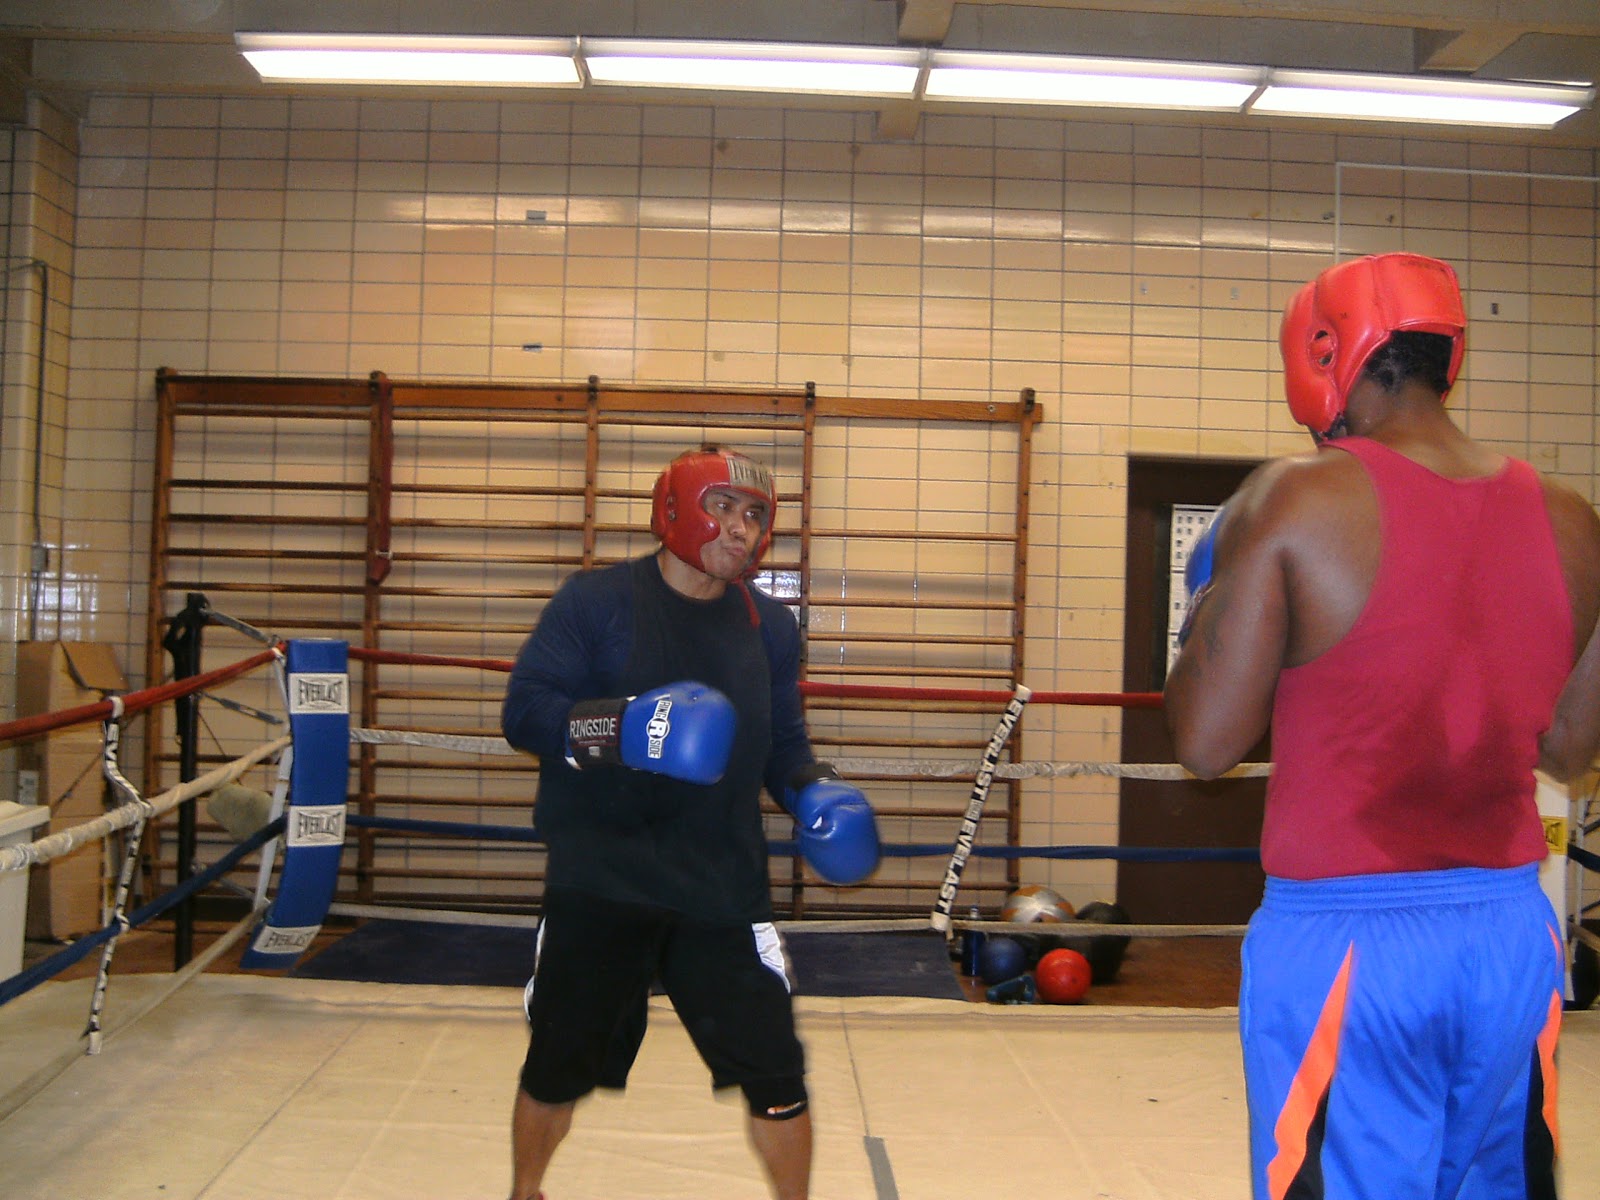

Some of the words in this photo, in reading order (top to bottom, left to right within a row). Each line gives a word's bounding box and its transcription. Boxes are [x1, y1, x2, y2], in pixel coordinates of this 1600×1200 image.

[656, 700, 671, 718] RING
[569, 717, 616, 739] RINGSIDE
[649, 720, 667, 737] R
[649, 739, 661, 757] SIDE
[972, 700, 1023, 801] EVERLAST
